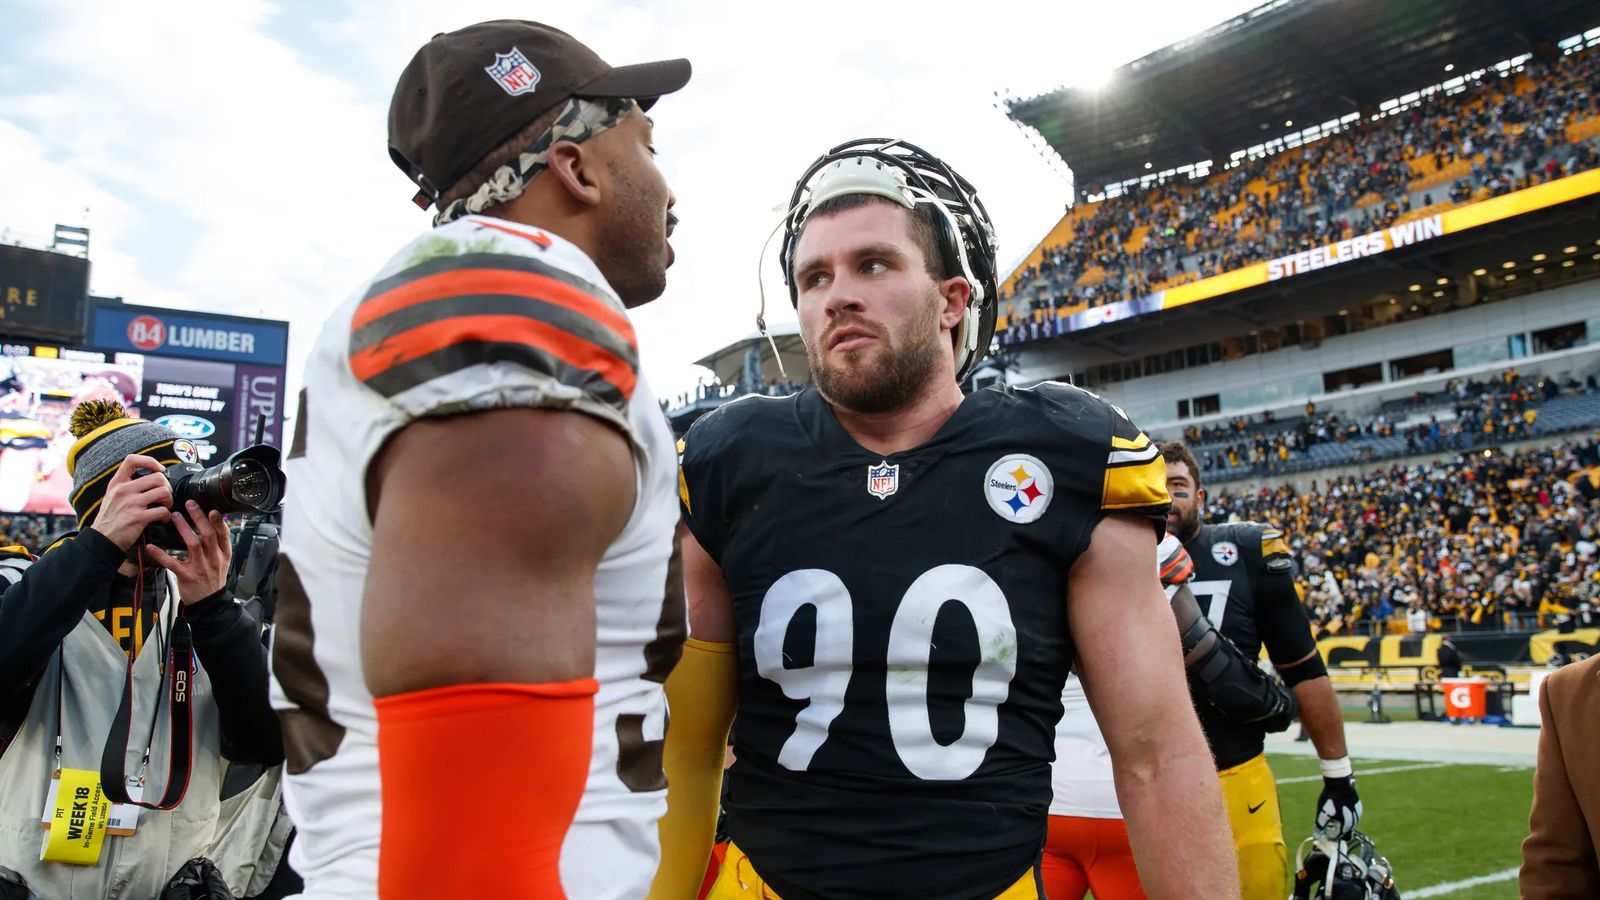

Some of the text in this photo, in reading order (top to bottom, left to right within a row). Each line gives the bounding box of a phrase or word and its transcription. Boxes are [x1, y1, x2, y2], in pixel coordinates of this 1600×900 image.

[503, 66, 536, 91] NFL
[1267, 214, 1443, 282] STEELERS WIN
[0, 286, 38, 306] RE
[132, 322, 255, 354] 84 LUMBER
[872, 476, 893, 491] NFL
[990, 478, 1017, 492] Steelers
[754, 563, 1018, 781] 90
[176, 670, 187, 702] EOS
[1449, 686, 1472, 709] G
[56, 808, 65, 819] PIT
[67, 787, 90, 840] WEEK 18
[89, 805, 98, 821] Field
[83, 822, 96, 849] In-Game
